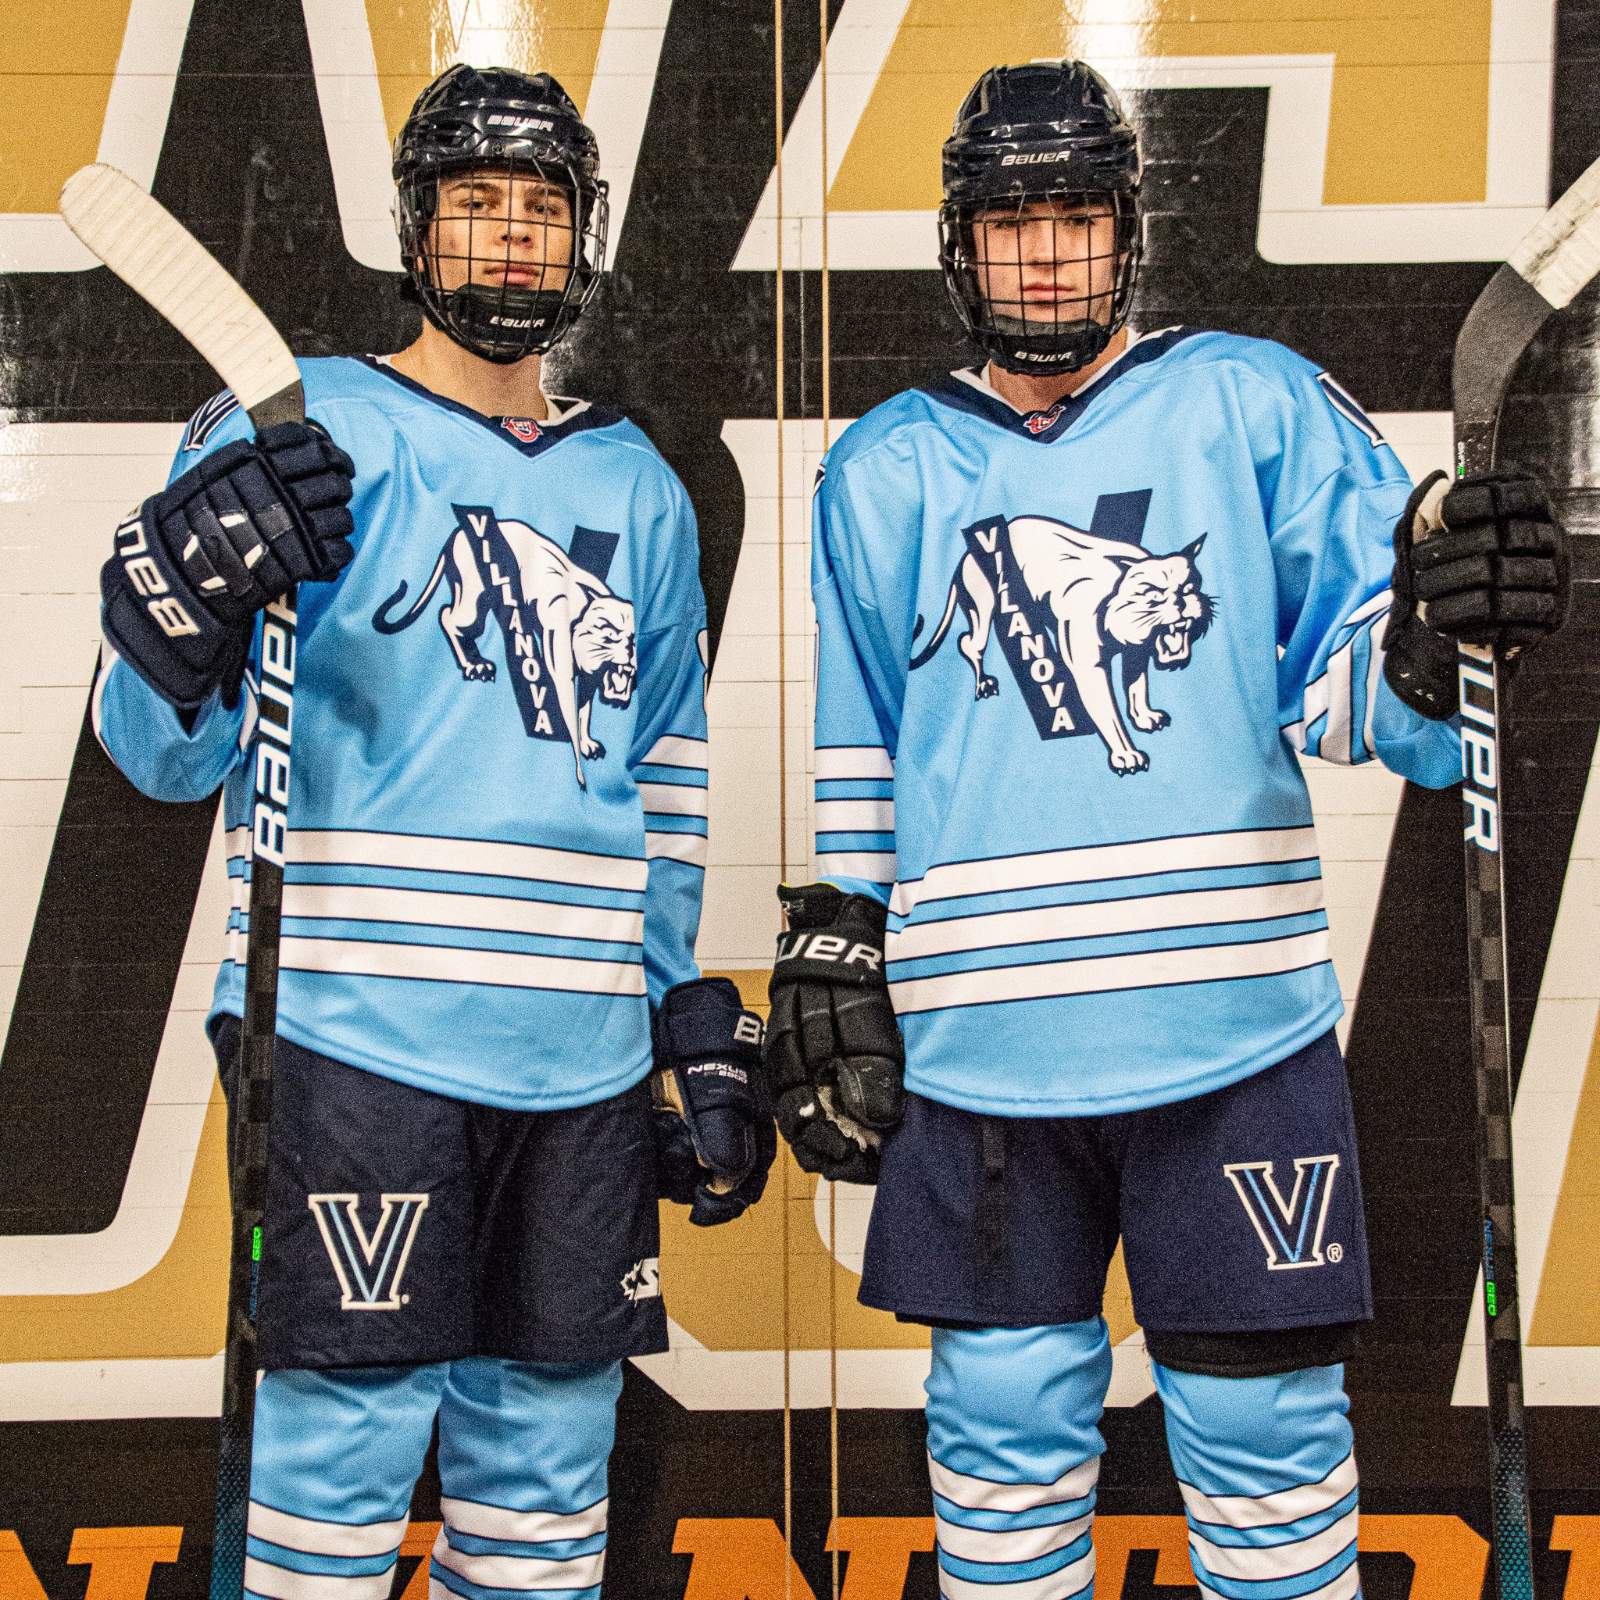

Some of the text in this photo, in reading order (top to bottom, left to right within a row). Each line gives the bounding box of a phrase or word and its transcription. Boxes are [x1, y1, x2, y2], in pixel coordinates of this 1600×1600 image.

[467, 513, 554, 735] VILLANOVA
[975, 526, 1076, 733] VILLANOVA
[1486, 1281, 1498, 1317] GEO
